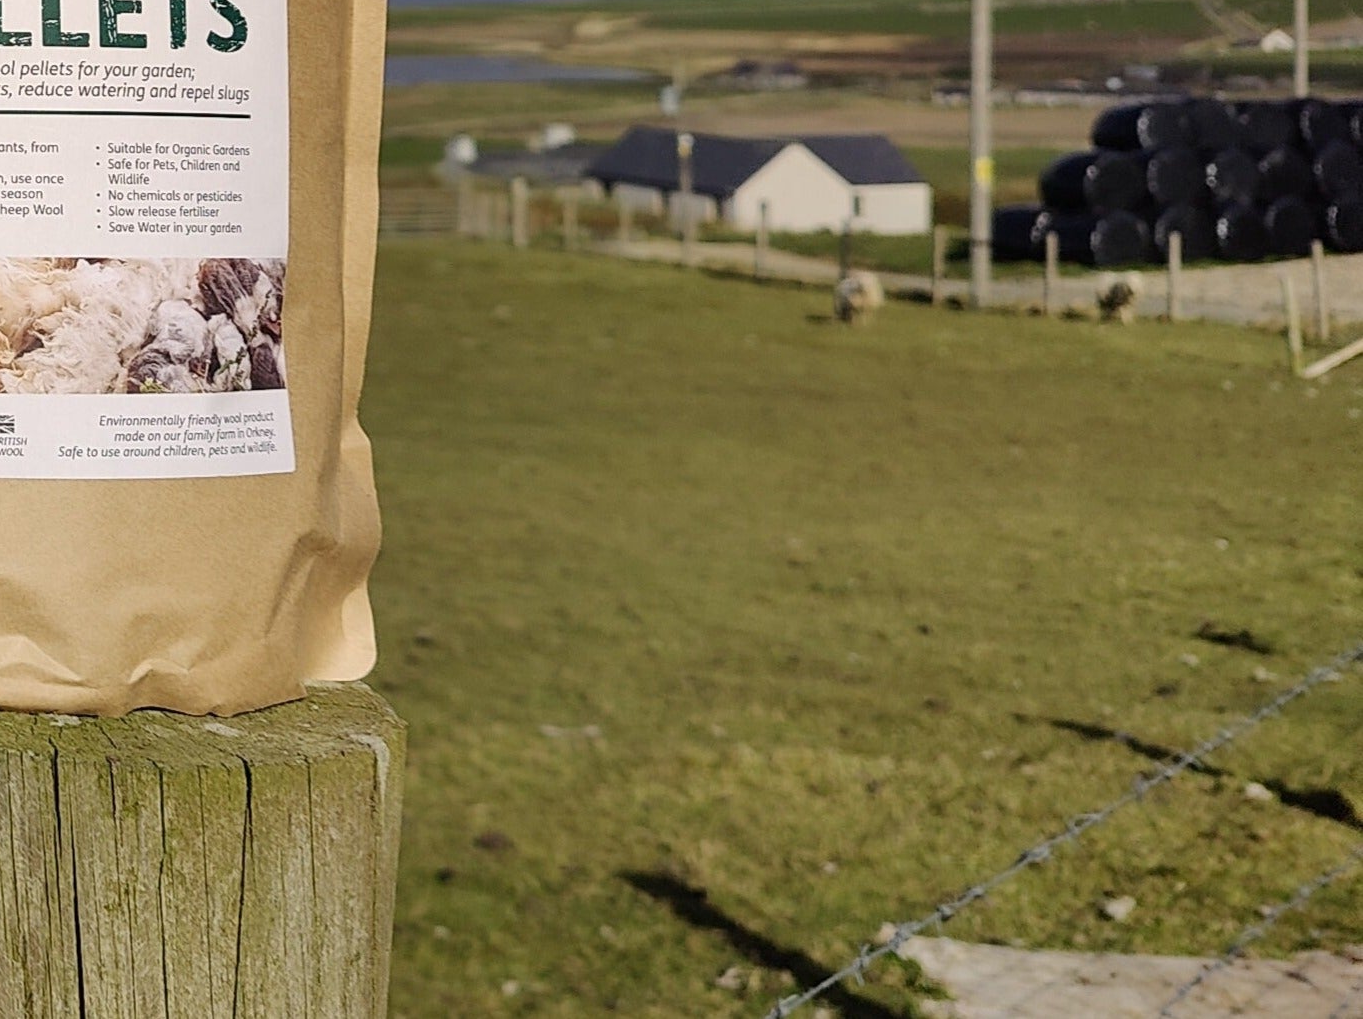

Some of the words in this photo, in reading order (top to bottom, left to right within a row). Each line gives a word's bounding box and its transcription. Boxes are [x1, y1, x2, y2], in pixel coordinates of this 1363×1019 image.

[20, 61, 73, 79] pellets
[78, 61, 100, 79] for
[103, 65, 137, 80] your
[142, 63, 195, 81] garden;
[18, 82, 73, 97] reduce
[78, 83, 145, 101] watering
[150, 84, 177, 99] and
[181, 85, 214, 102] repel
[217, 86, 250, 104] slugs
[31, 142, 59, 153] from
[108, 143, 152, 154] Suitable
[155, 143, 169, 154] for
[172, 144, 210, 157] Organic
[213, 145, 250, 156] Gardens
[108, 159, 132, 170] Safe
[135, 159, 150, 170] for
[153, 159, 178, 172] Pets,
[181, 160, 220, 171] Children
[223, 161, 240, 171] and
[11, 175, 32, 183] use
[35, 175, 64, 184] once
[108, 174, 149, 185] Wildlife
[1, 190, 43, 199] season
[109, 190, 124, 201] No
[127, 190, 180, 201] chemicals
[197, 191, 242, 204] pesticides
[33, 204, 63, 215] Wool
[109, 206, 134, 216] Slow
[138, 206, 176, 217] release
[179, 207, 220, 217] fertiliser
[109, 222, 134, 232] Save
[138, 222, 171, 232] Water
[173, 222, 183, 232] in
[186, 225, 208, 235] your
[210, 223, 242, 235] garden
[99, 415, 185, 428] Environmentally
[187, 414, 222, 427] friendly
[224, 413, 242, 423] wool
[243, 412, 274, 423] product
[114, 431, 145, 442] made
[148, 432, 161, 441] on
[164, 432, 181, 441] our
[183, 430, 214, 443] family
[58, 446, 83, 460] Safe
[87, 447, 98, 457] to
[101, 448, 120, 457] use
[123, 446, 160, 457] around
[164, 445, 206, 457] children,
[208, 445, 228, 457] pets
[230, 443, 245, 454] and
